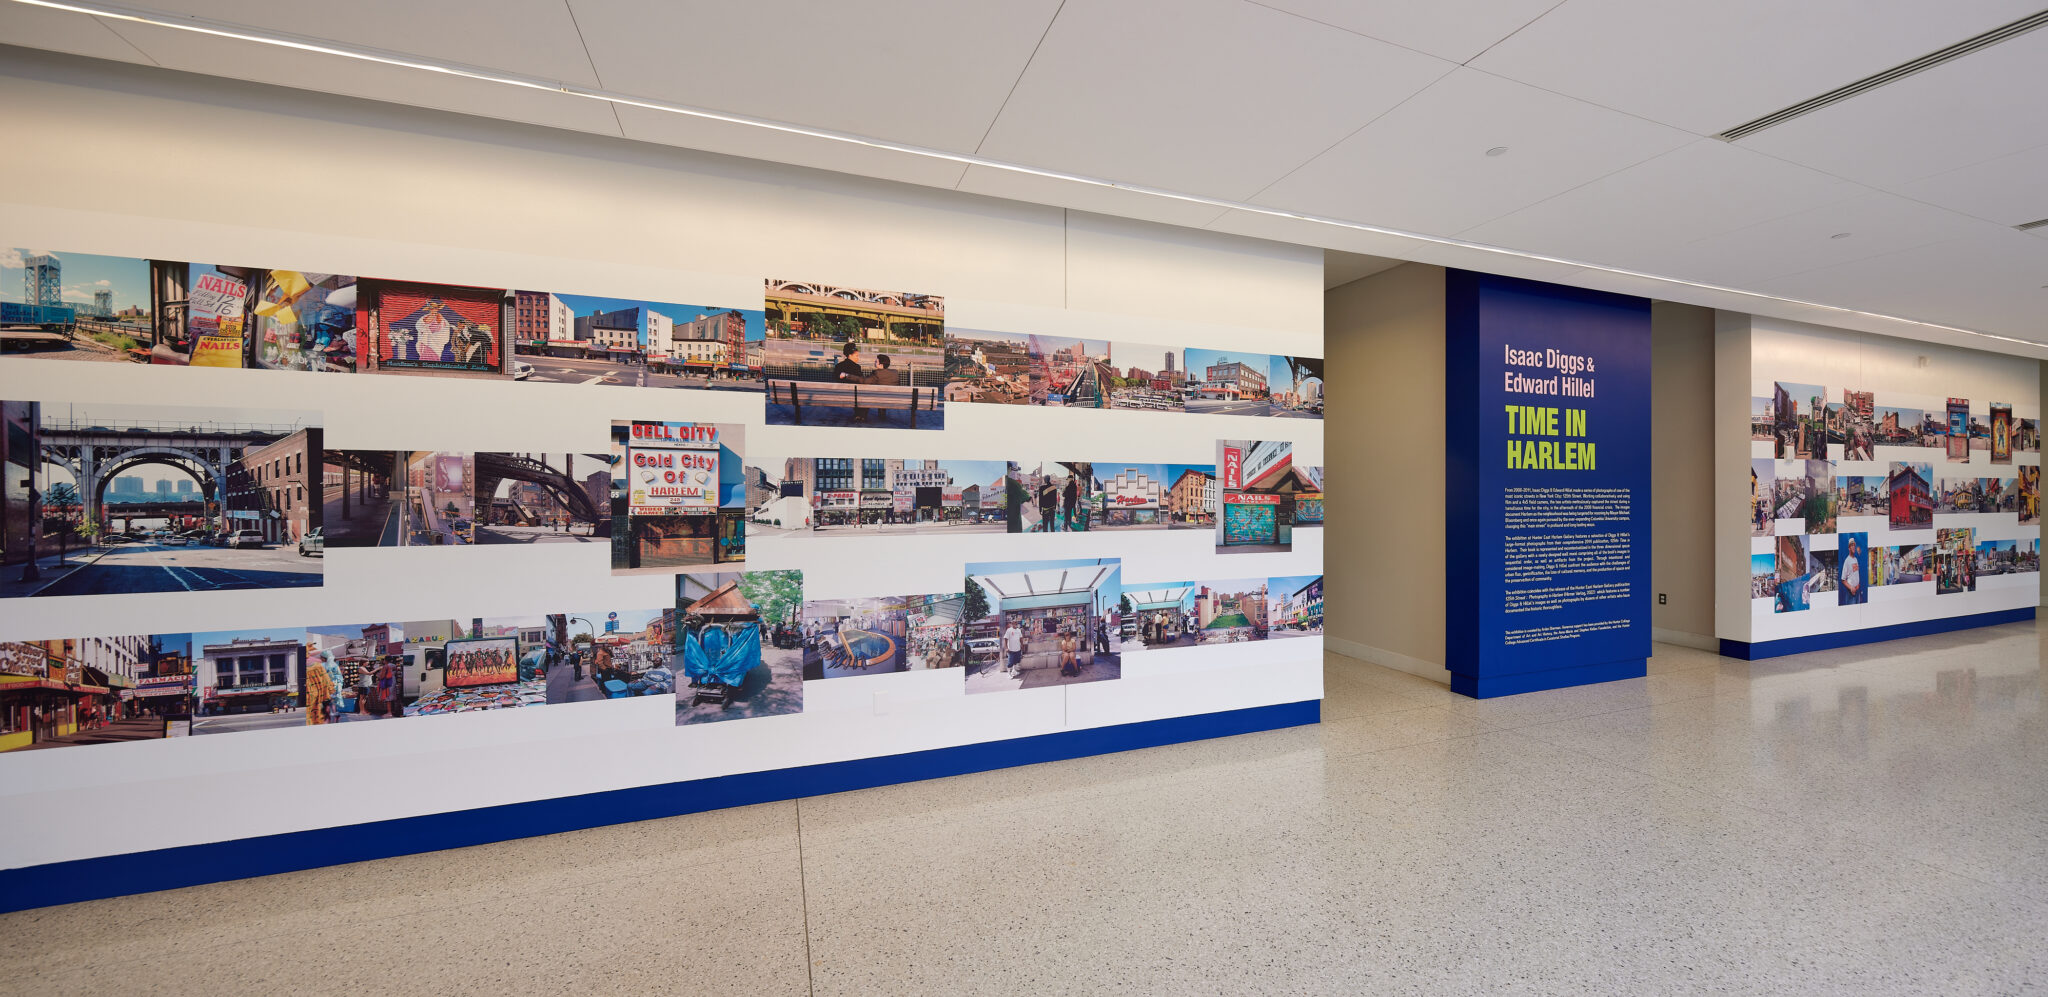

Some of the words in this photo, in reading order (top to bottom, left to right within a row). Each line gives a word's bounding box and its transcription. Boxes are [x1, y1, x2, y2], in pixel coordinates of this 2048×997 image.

[198, 275, 246, 298] NAILS
[215, 304, 233, 315] 16
[199, 342, 240, 350] NAILS
[1505, 344, 1542, 368] Isaac
[1546, 349, 1584, 375] Diggs
[1587, 357, 1595, 372] &
[1505, 372, 1557, 395] Edward
[1562, 377, 1595, 398] Hillel
[1505, 405, 1559, 436] TIME
[1566, 408, 1586, 437] IN
[632, 424, 672, 438] CELL
[680, 426, 716, 440] CITY
[634, 453, 672, 467] Gold
[681, 454, 715, 470] City
[1507, 440, 1596, 470] HARLEM
[664, 470, 686, 483] Of
[1227, 454, 1238, 488] NAILS
[651, 487, 698, 495] HARLEM
[1116, 495, 1147, 506] Harlem
